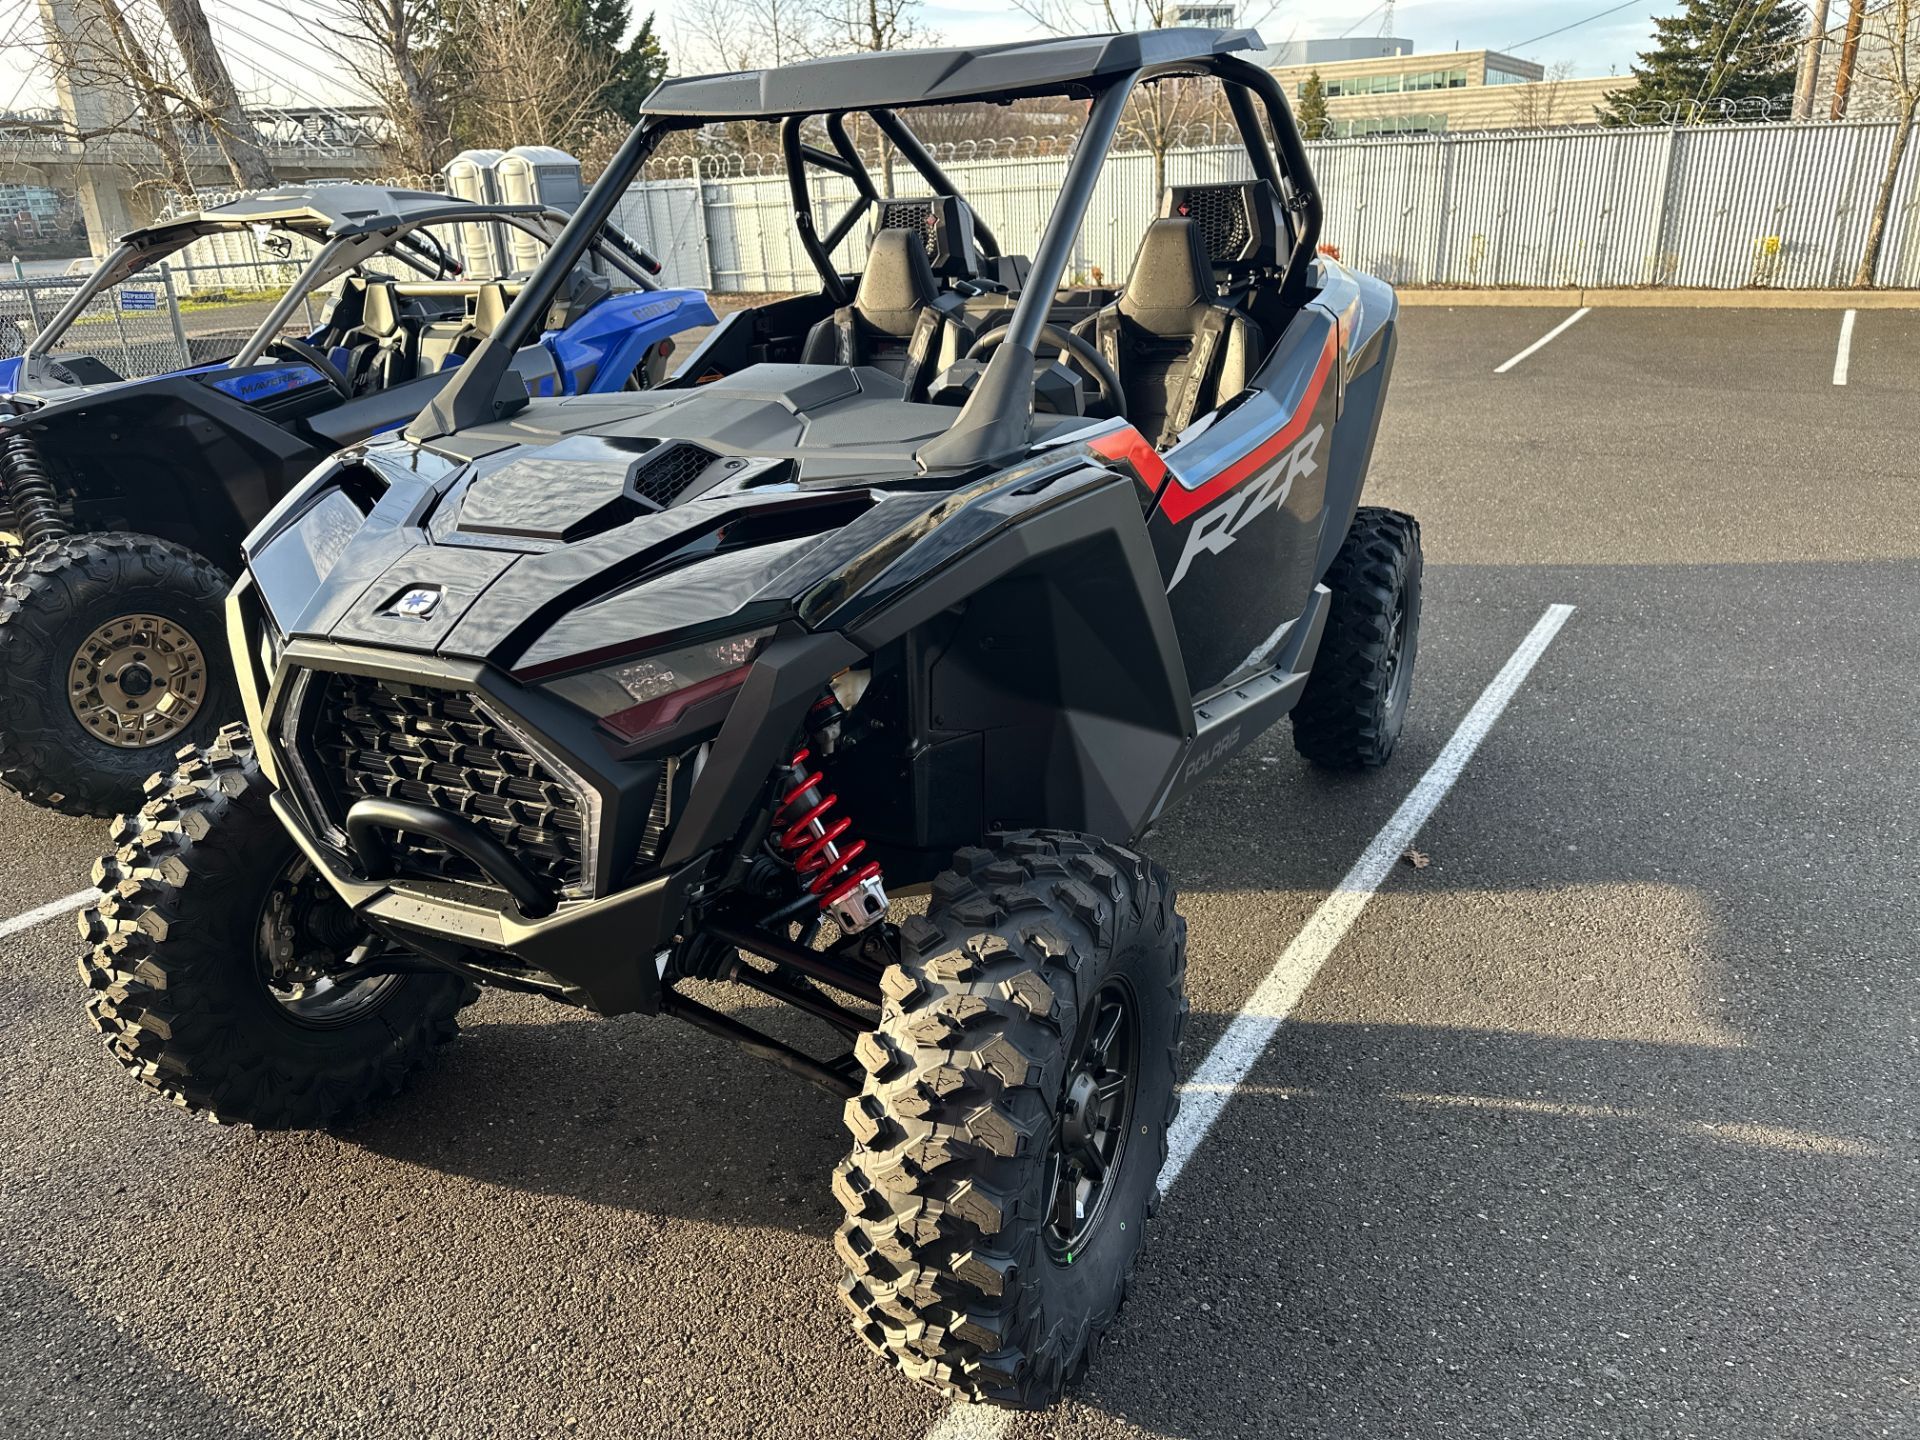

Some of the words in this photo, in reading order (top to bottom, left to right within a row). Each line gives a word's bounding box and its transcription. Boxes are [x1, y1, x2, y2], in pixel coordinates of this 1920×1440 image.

[122, 292, 155, 300] SUPERIOR
[1165, 424, 1325, 596] RZR
[1184, 723, 1241, 783] POLARIS
